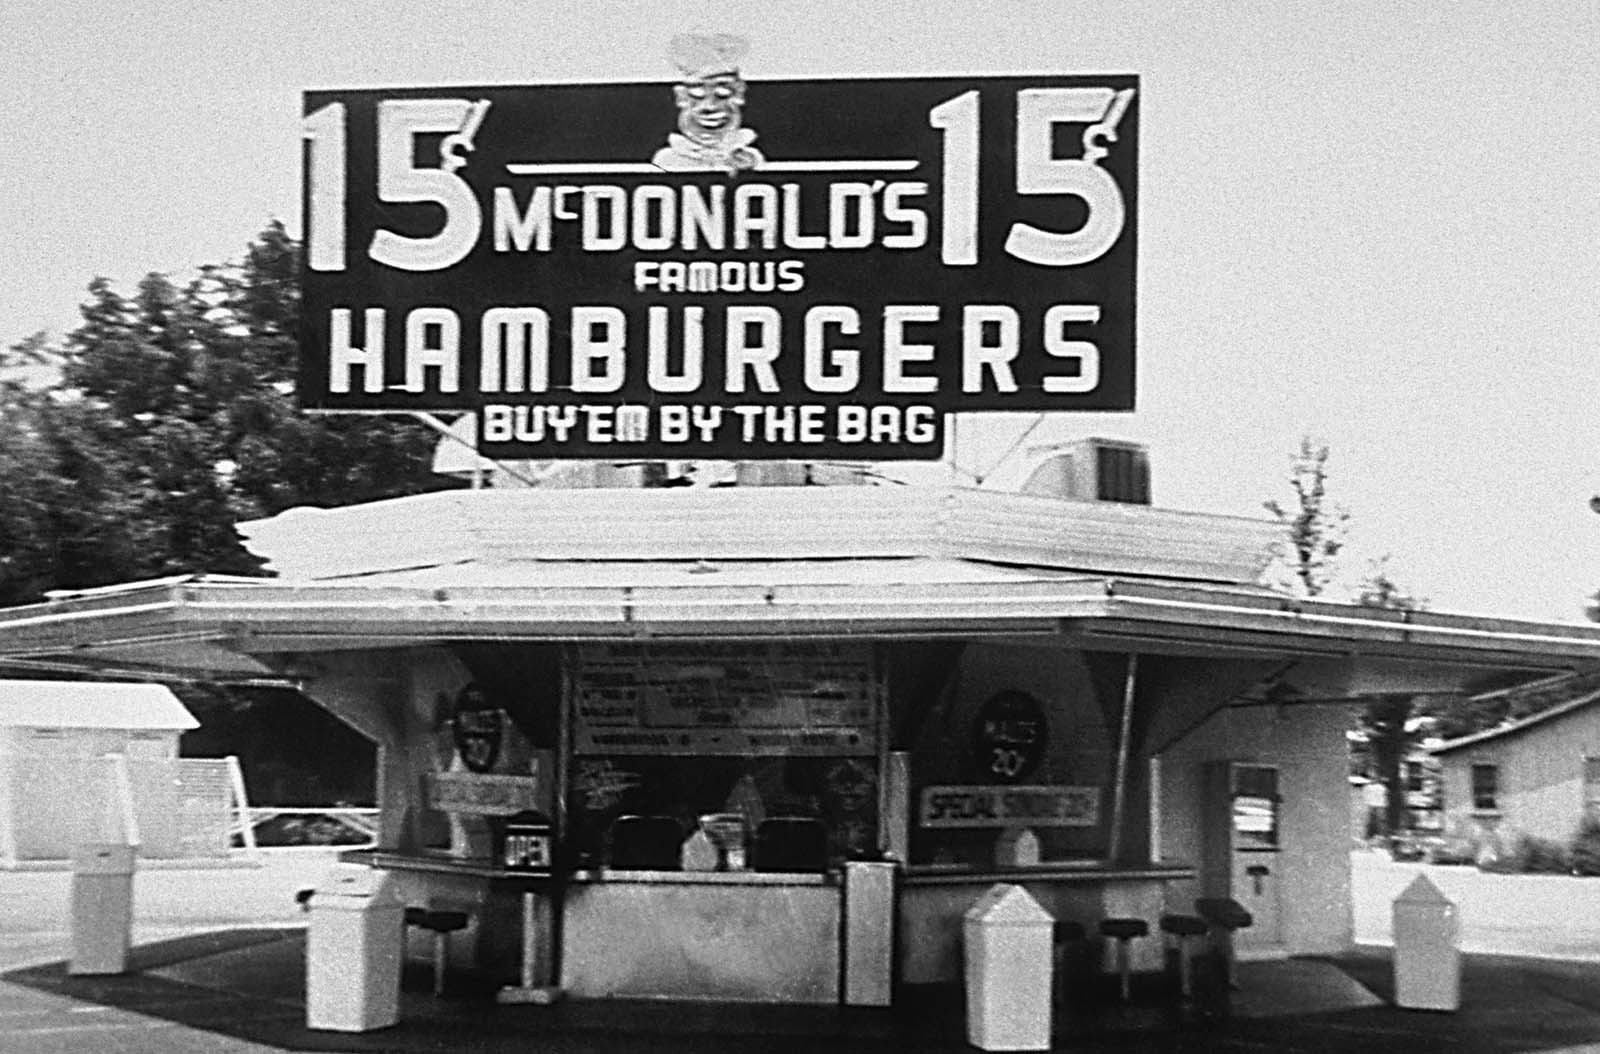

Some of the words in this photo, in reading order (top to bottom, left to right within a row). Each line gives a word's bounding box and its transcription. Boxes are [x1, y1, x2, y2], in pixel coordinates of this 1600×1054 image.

[634, 260, 804, 292] FAMOUS
[329, 304, 1101, 393] HAMBURGERS
[660, 404, 722, 442] BY
[732, 404, 826, 442] THE
[836, 404, 935, 443] BAG
